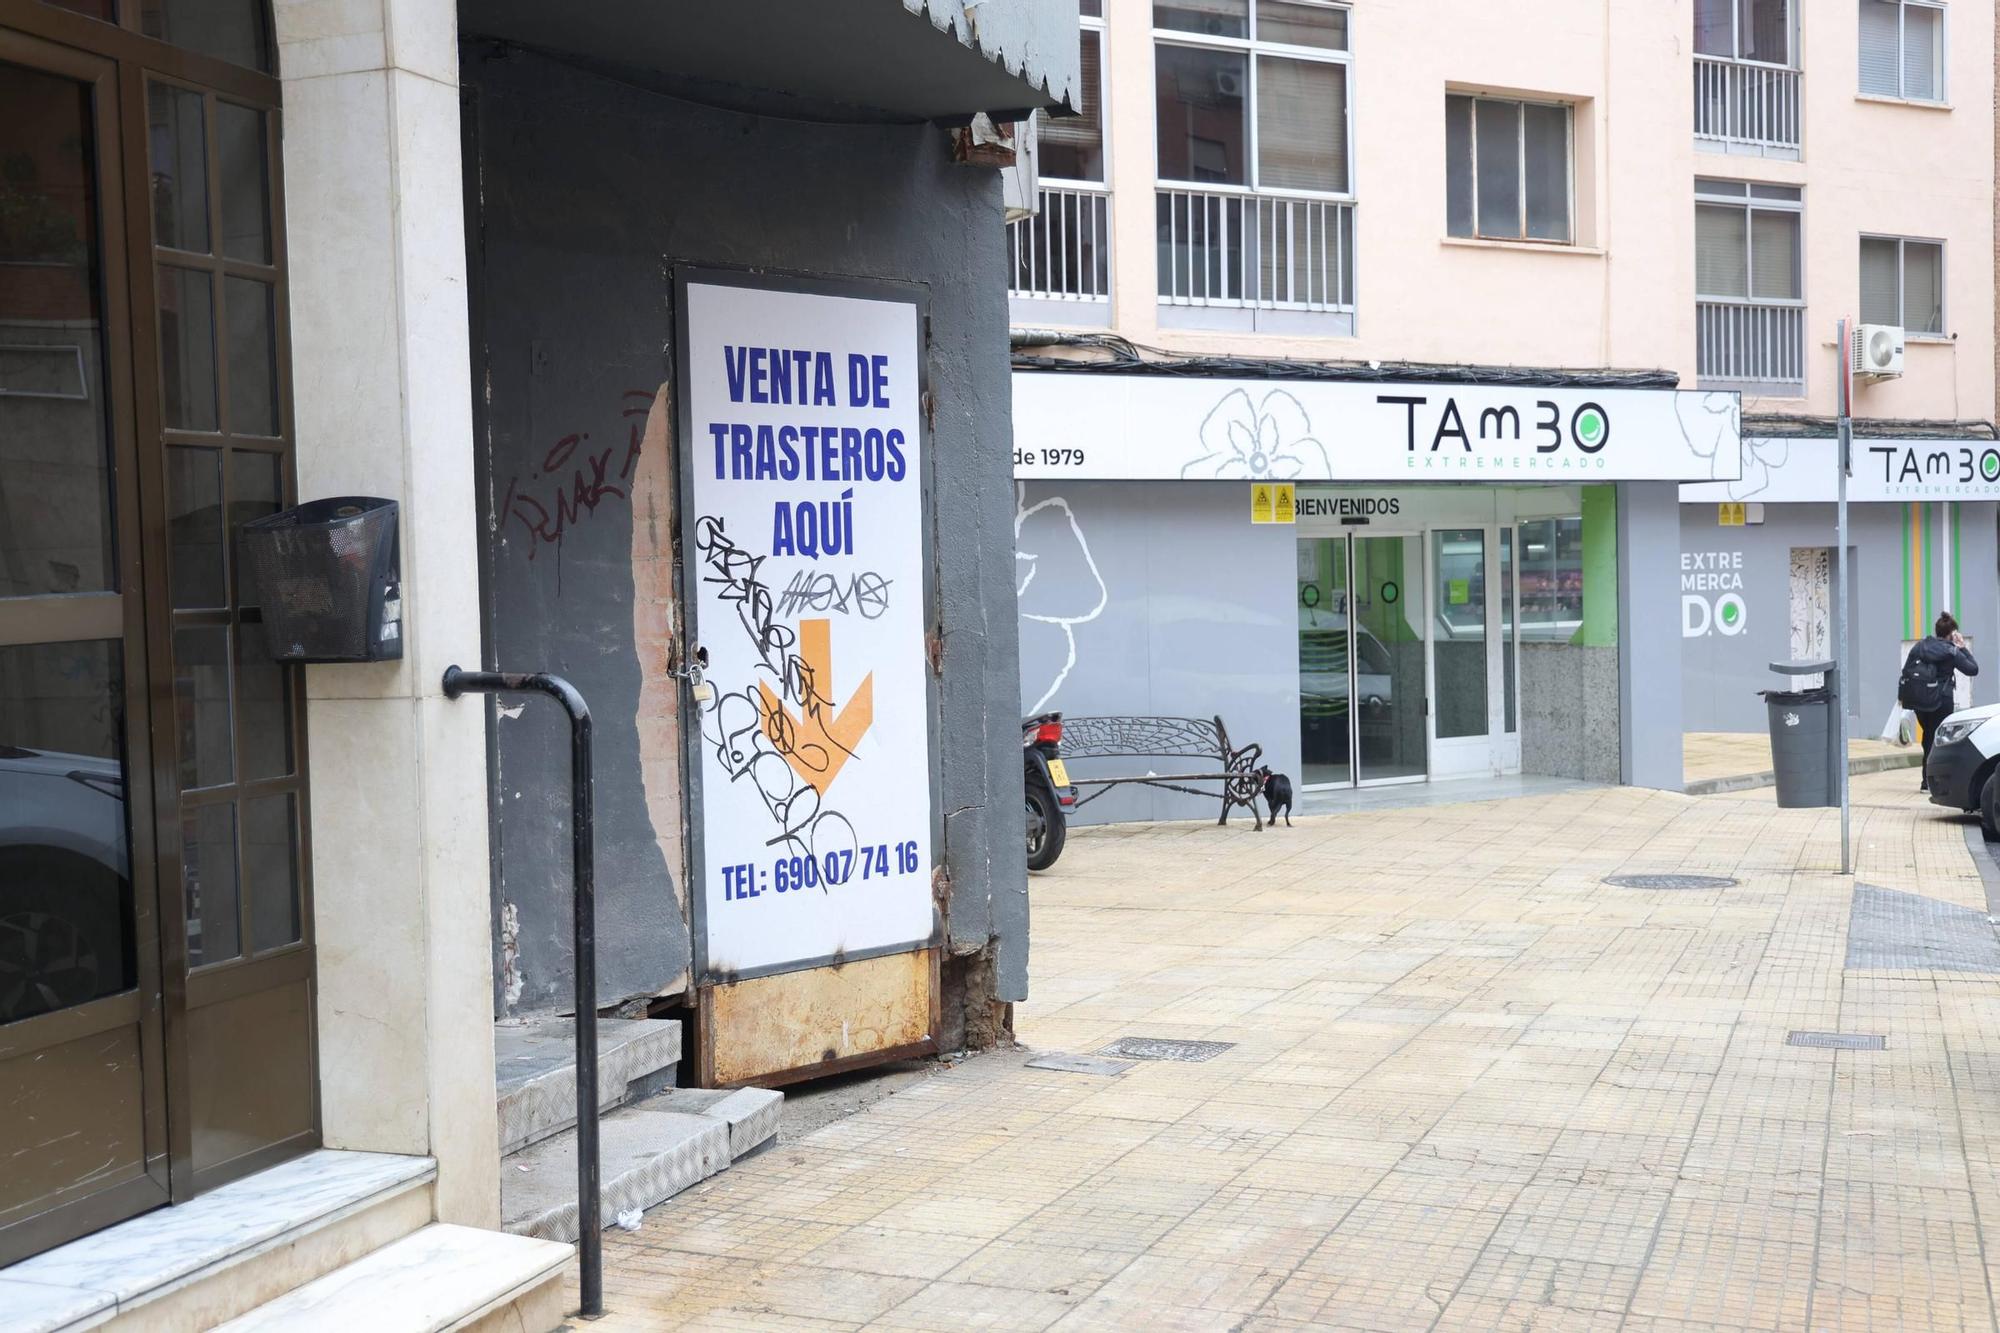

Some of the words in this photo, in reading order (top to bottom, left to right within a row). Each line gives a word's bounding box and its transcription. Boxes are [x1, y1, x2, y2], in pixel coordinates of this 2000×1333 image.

[723, 345, 836, 407] VENTA
[848, 353, 890, 409] DE
[709, 423, 906, 482] TRASTEROS
[1013, 447, 1036, 466] de
[1040, 448, 1085, 466] 1979
[1407, 456, 1605, 469] EXTREMERCADO
[772, 487, 853, 561] AQUÍ
[1681, 551, 1744, 571] EXTRE
[1681, 572, 1744, 592] MERCA
[721, 862, 767, 902] TEL:
[774, 853, 819, 894] 690
[824, 848, 854, 886] 07
[860, 843, 890, 881] 74
[894, 840, 919, 875] 16
